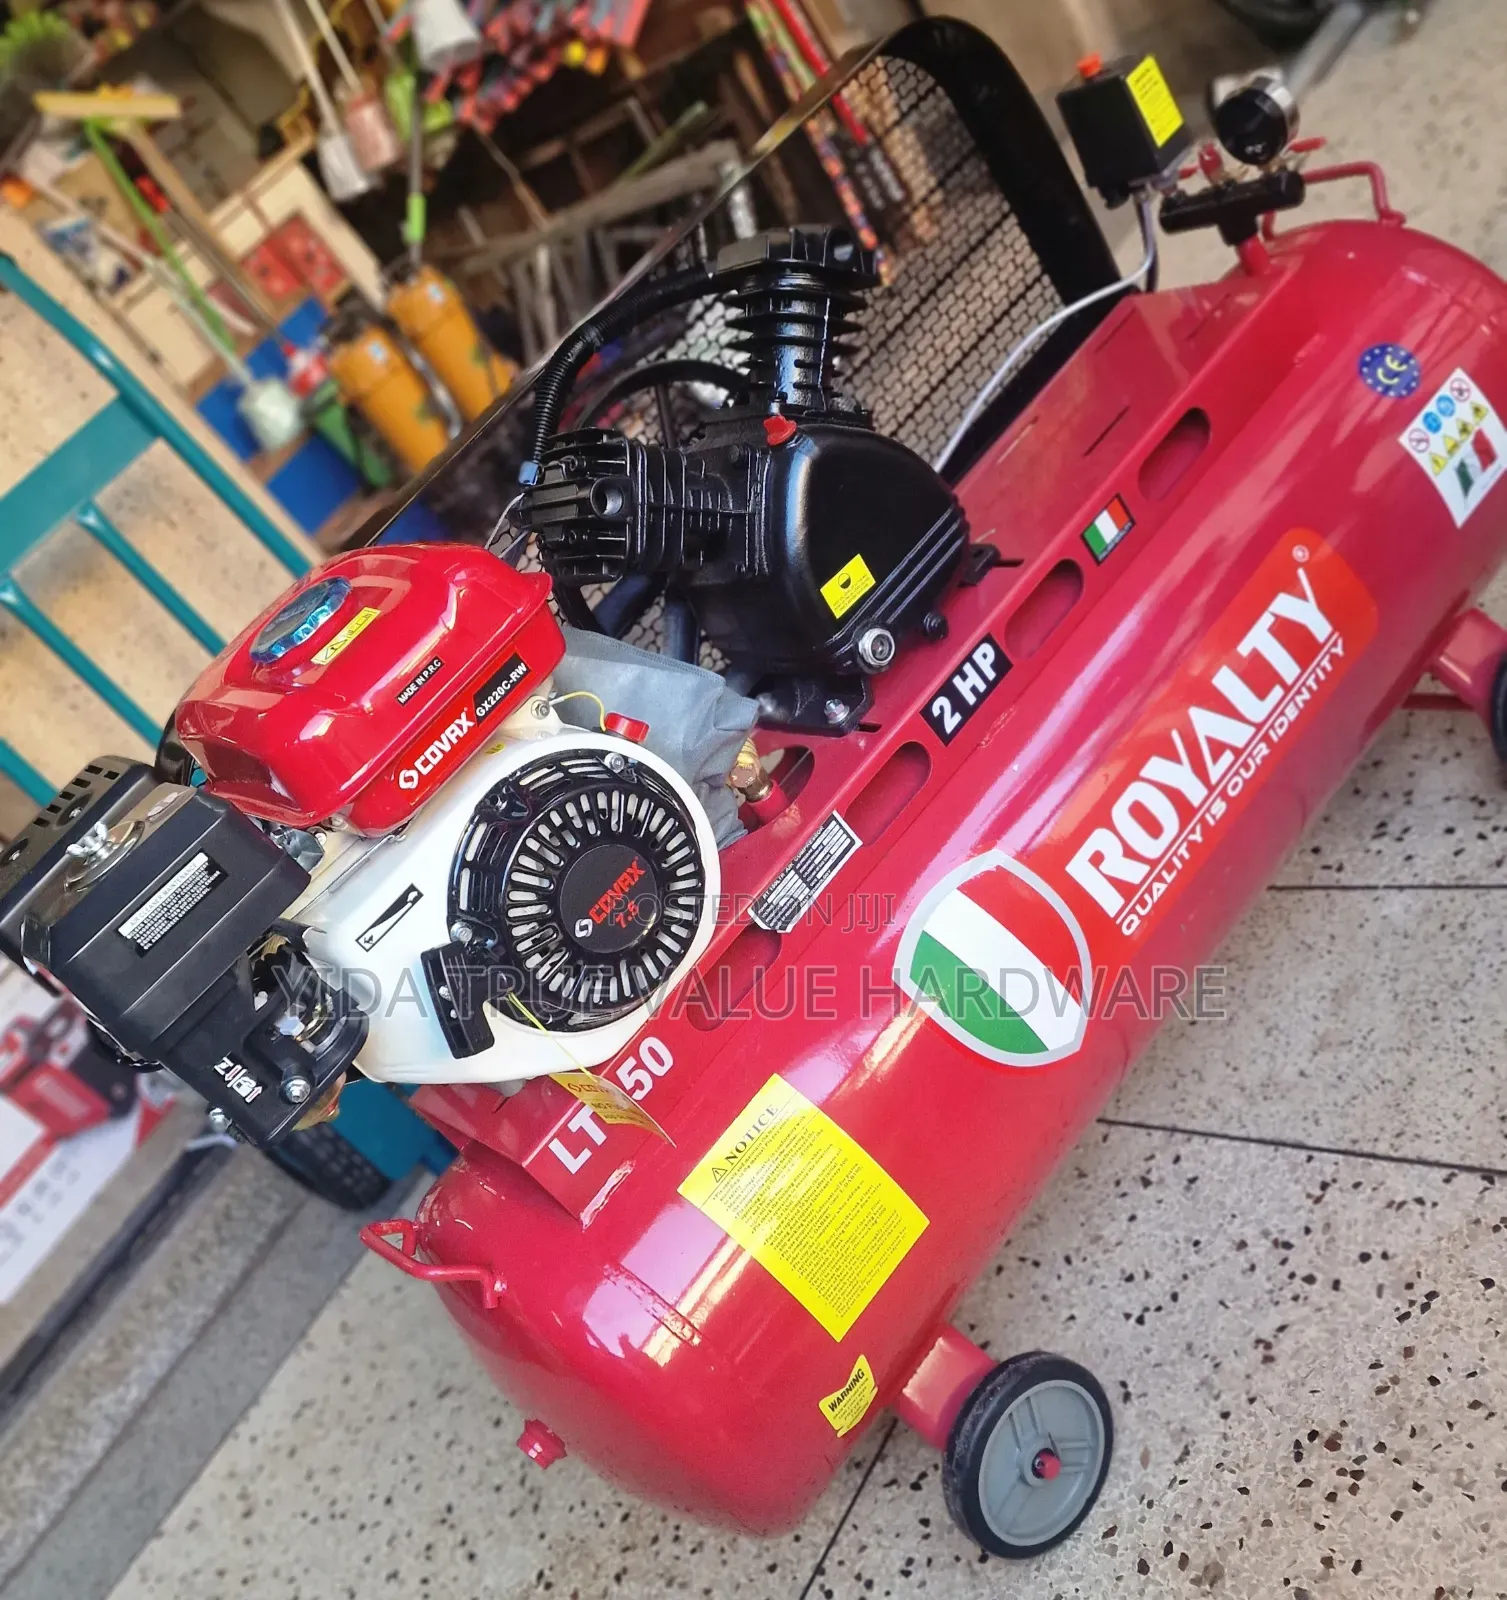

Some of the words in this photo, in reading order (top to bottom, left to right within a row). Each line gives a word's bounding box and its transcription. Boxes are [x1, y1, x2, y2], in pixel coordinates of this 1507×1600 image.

[397, 683, 419, 704] MADE
[415, 676, 426, 687] IN
[475, 662, 528, 718] GX220C-RW
[932, 695, 962, 735] 2
[952, 642, 997, 706] HP
[413, 710, 475, 776] COVAX
[1065, 567, 1333, 918] ROYALTY
[1121, 823, 1203, 935] QUALITY
[1205, 797, 1228, 826] IS
[1226, 741, 1271, 797] OUR
[1268, 637, 1346, 743] IDENTITY
[129, 915, 140, 926] AIR
[137, 894, 163, 918] CLEANER
[161, 861, 197, 896] MAINTENANCE
[588, 859, 646, 924] COVAX
[724, 1103, 780, 1167] NOTICE
[827, 1368, 865, 1412] WARNING
